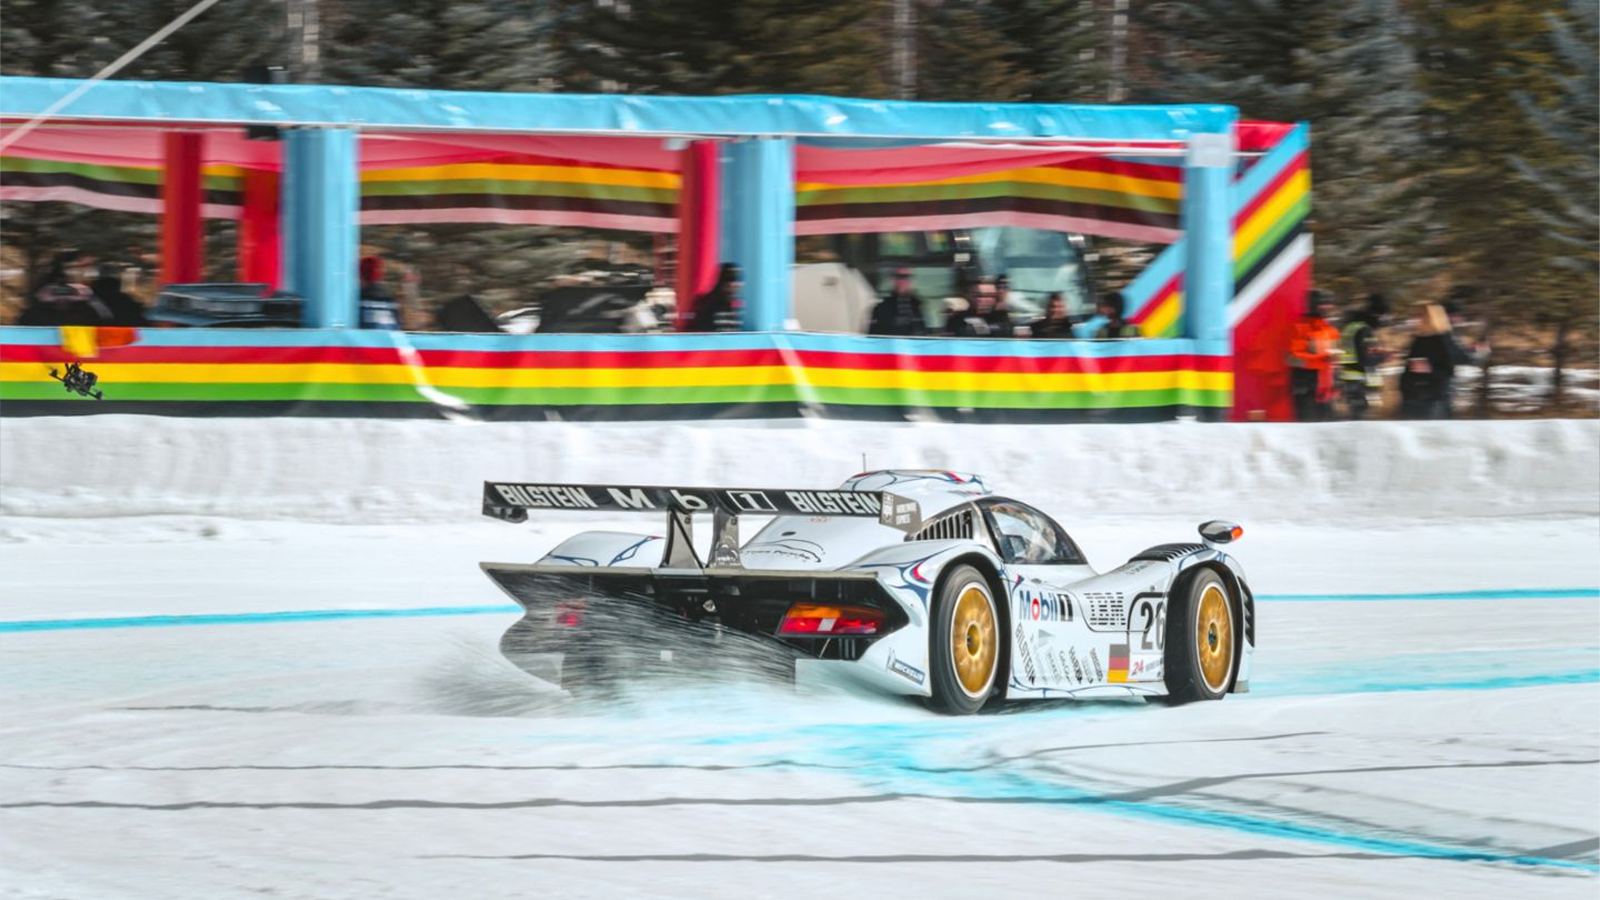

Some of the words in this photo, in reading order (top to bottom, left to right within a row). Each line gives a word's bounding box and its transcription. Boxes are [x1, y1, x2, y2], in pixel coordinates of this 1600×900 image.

[494, 484, 598, 508] BILSTEIN
[785, 491, 880, 515] BILSTEIN
[1019, 590, 1057, 622] Mobil
[1057, 593, 1073, 622] 1
[1083, 591, 1126, 626] IBM
[1140, 601, 1166, 650] 26
[1015, 621, 1036, 685] BILSTEIN
